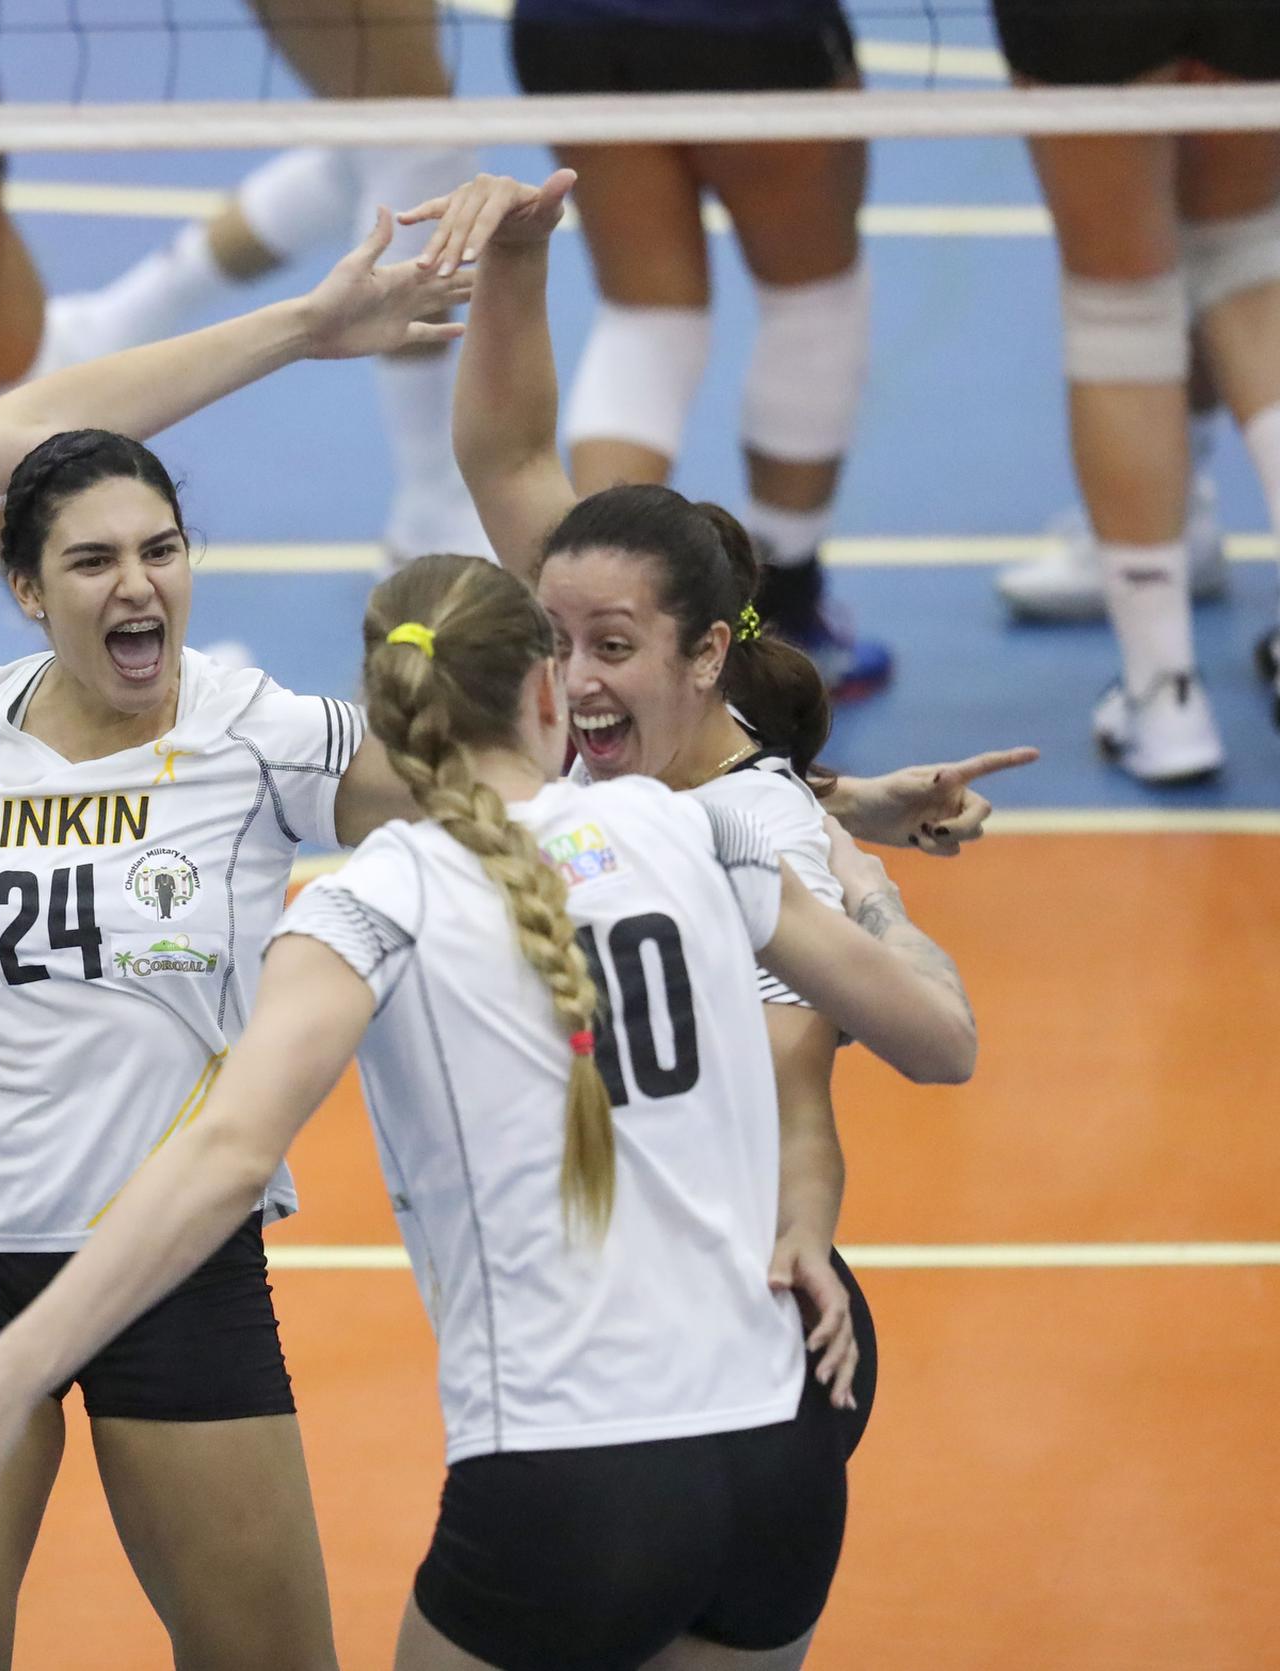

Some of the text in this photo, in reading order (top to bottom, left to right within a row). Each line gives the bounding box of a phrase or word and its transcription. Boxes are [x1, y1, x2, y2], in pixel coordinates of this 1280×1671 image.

[124, 847, 201, 891] Christian Military Academy
[131, 958, 206, 977] COROZAL
[575, 912, 700, 1106] 10
